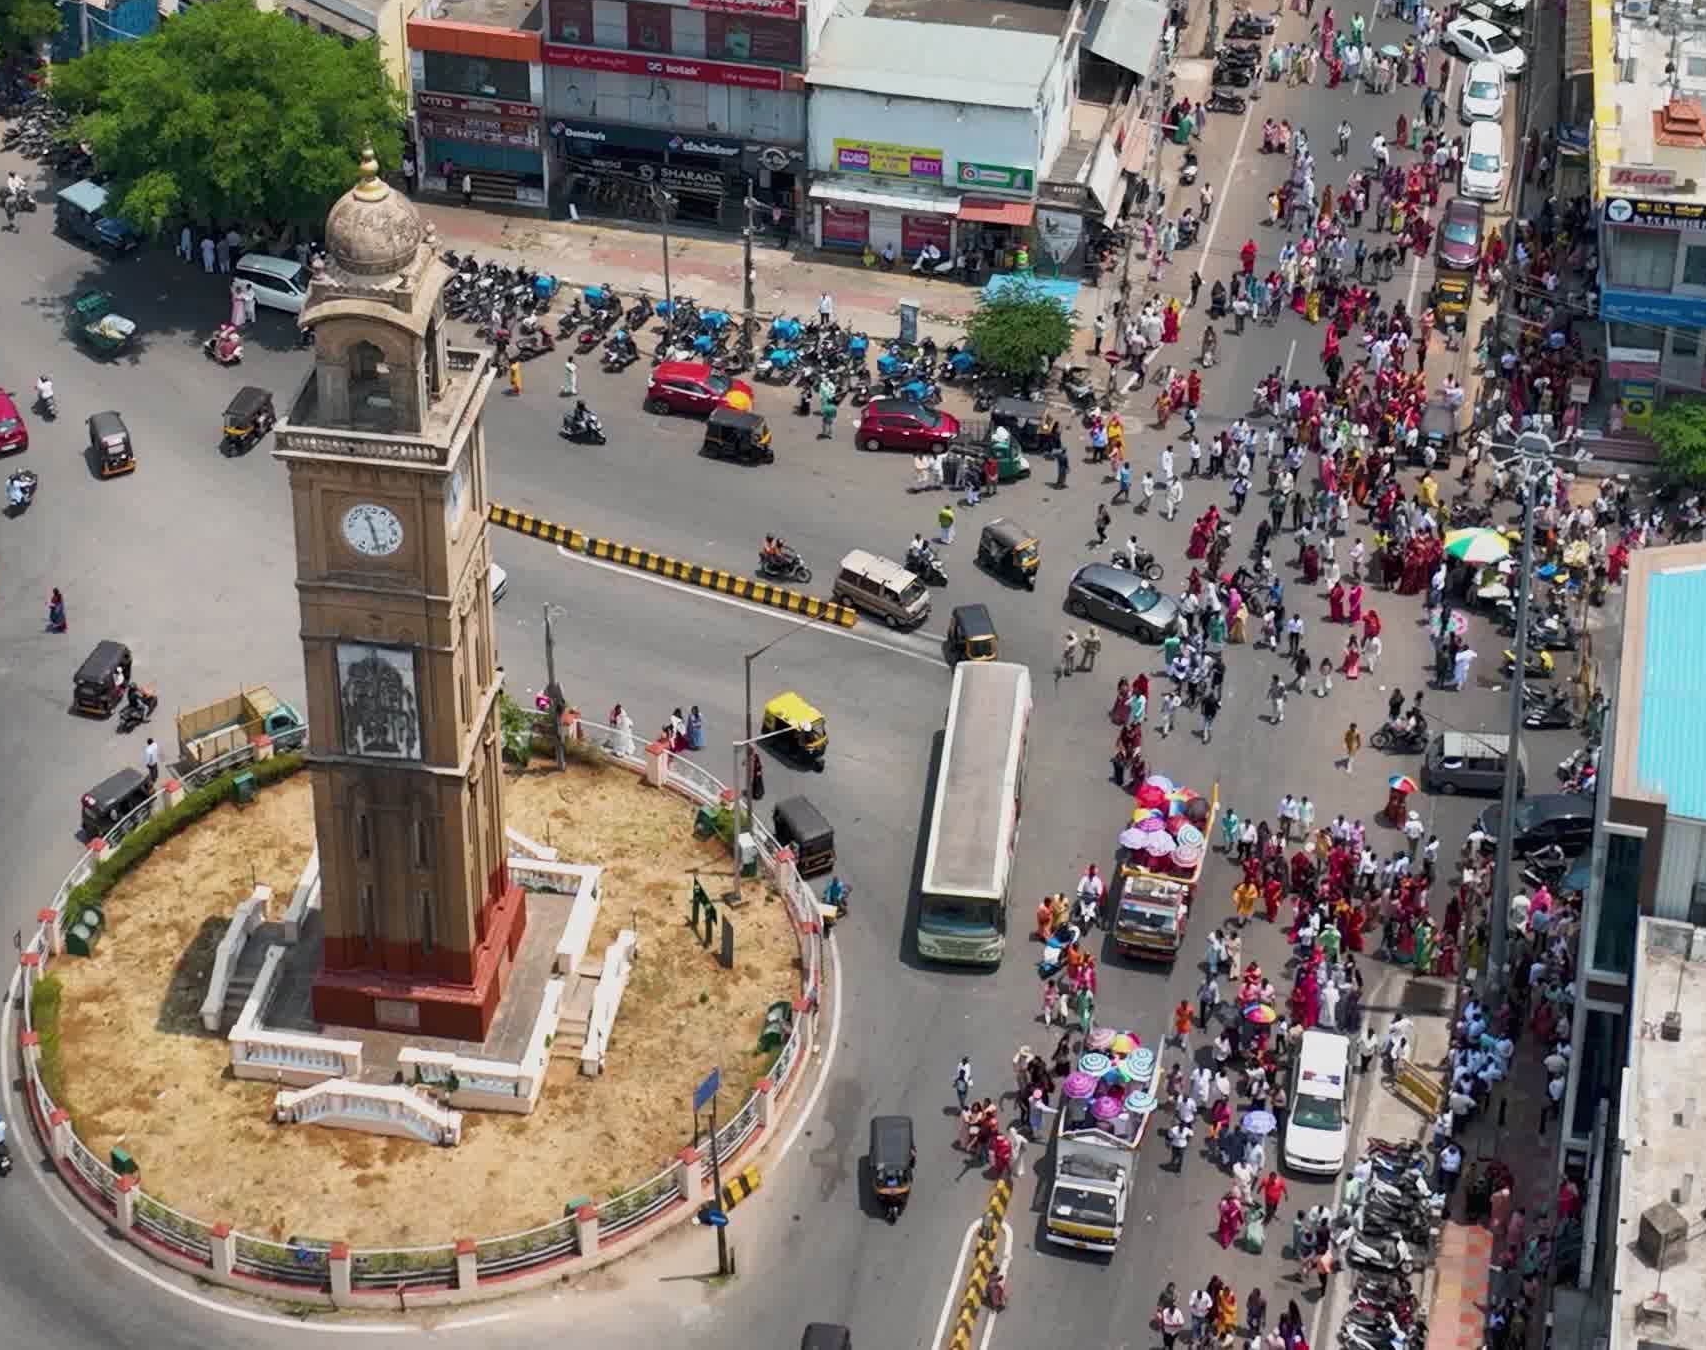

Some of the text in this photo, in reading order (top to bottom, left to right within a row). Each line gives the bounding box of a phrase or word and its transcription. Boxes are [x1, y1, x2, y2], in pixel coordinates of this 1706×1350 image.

[421, 95, 453, 107] VITO
[661, 167, 724, 184] SHARADA
[1612, 170, 1671, 185] Bata
